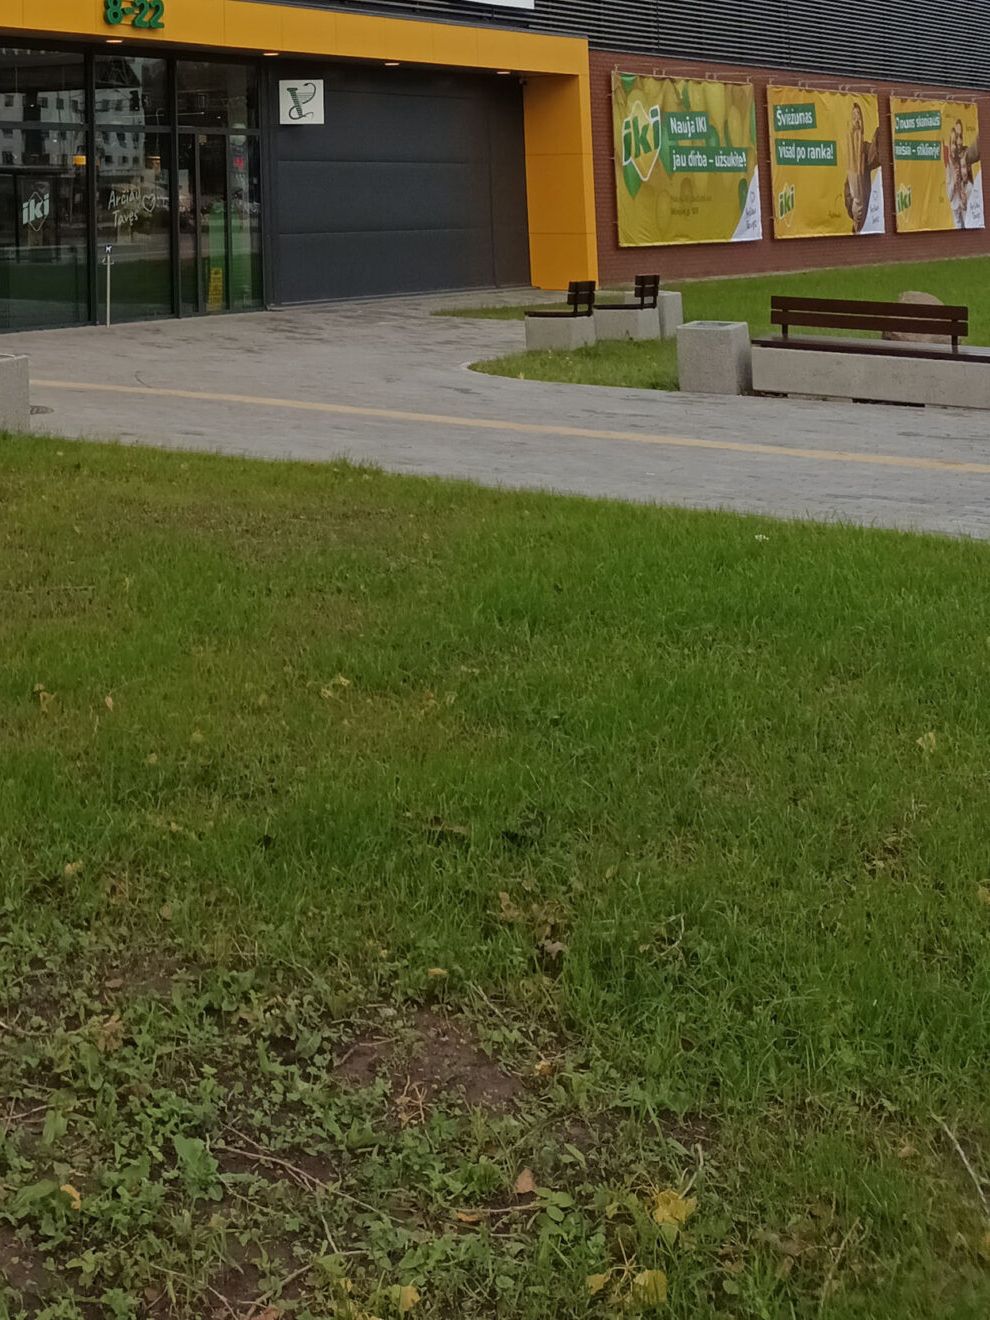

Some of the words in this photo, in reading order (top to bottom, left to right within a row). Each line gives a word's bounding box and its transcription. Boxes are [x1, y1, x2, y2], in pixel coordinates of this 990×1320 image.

[623, 106, 661, 164] iki
[669, 116, 695, 138] Nauja
[696, 116, 707, 132] IKI
[672, 149, 687, 170] jau
[688, 150, 707, 167] dirba
[797, 146, 806, 163] po
[22, 193, 50, 225] iki
[779, 185, 795, 219] iki
